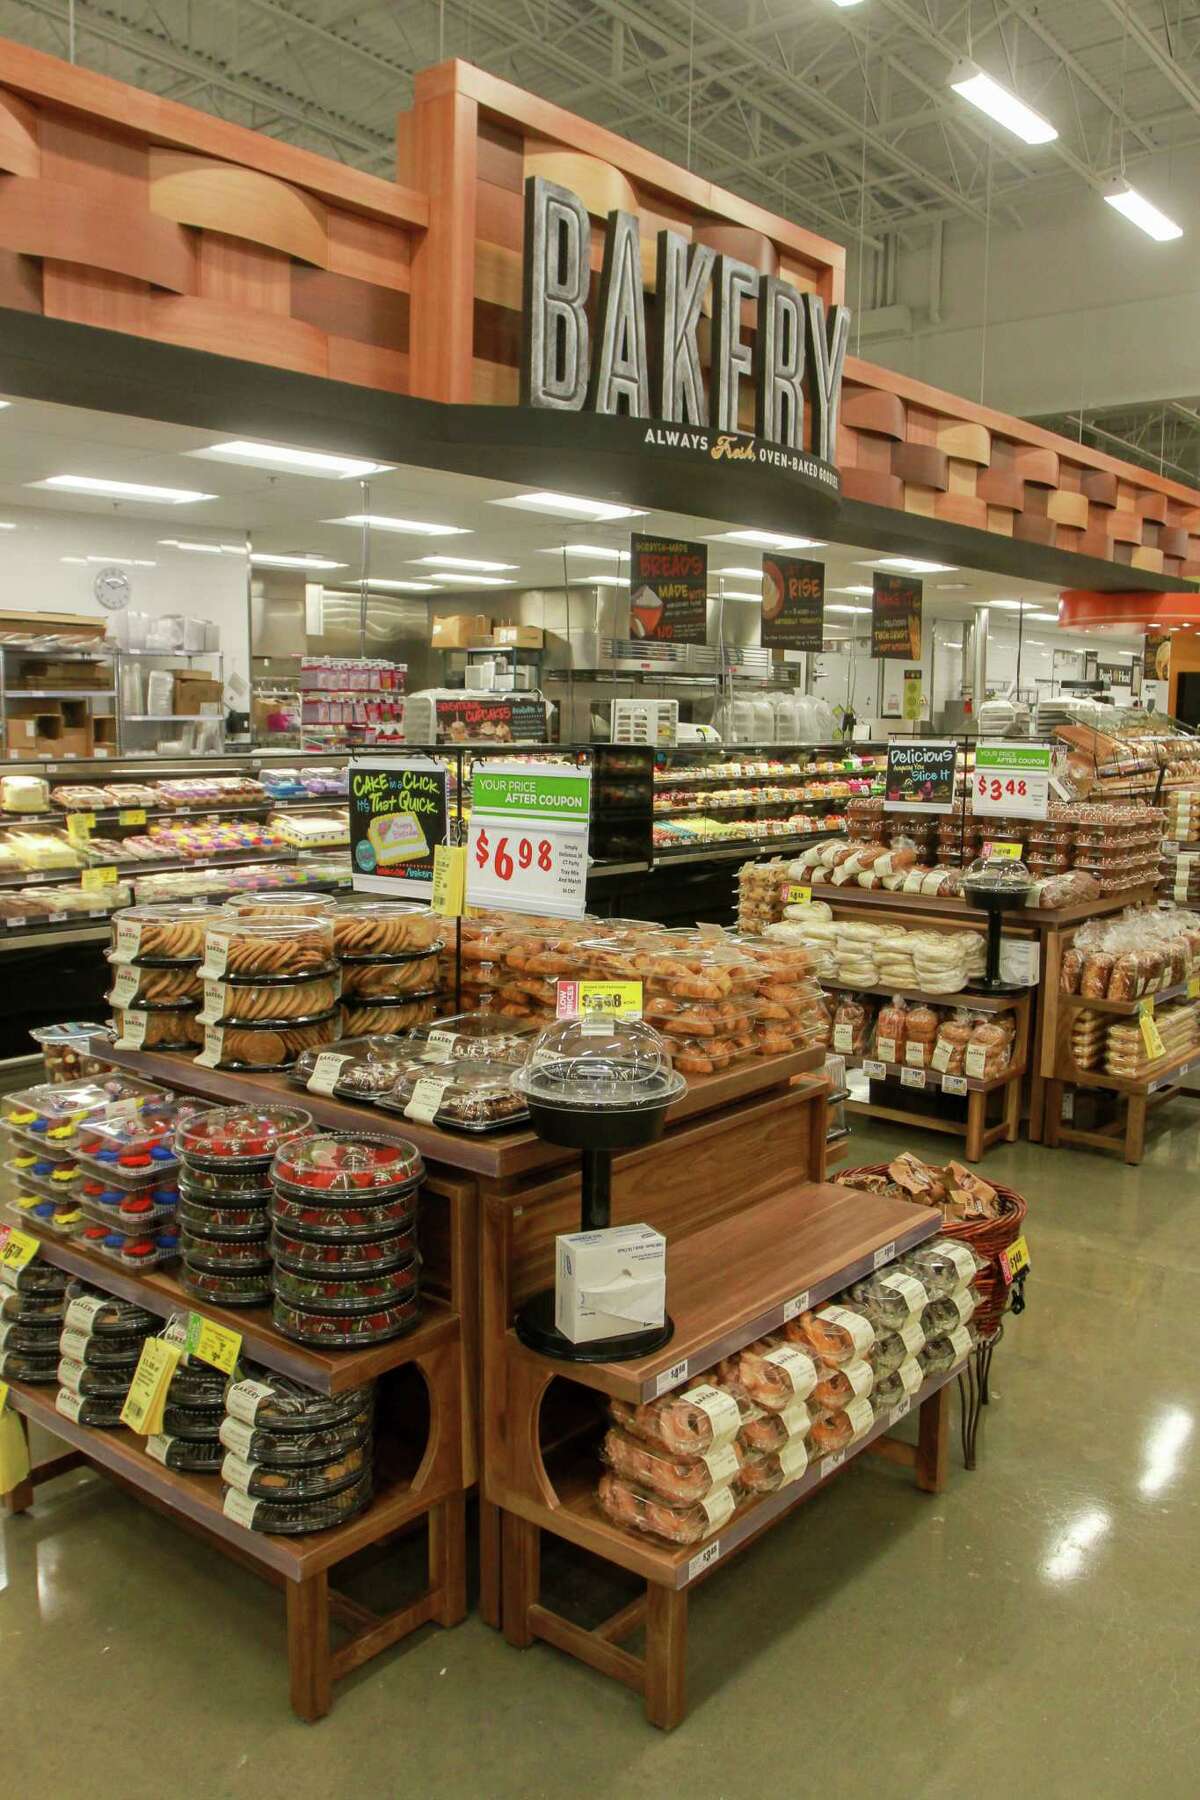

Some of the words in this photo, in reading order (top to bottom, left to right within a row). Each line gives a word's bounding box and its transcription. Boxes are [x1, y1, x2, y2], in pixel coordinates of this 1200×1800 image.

[525, 176, 851, 467] BAKERY
[644, 428, 708, 450] ALWAYS
[760, 448, 818, 478] OVEN-BAKED
[658, 584, 689, 598] MADE
[788, 578, 821, 599] RISE
[890, 747, 954, 764] Delicious
[981, 750, 998, 758] YOUR
[912, 770, 938, 781] Slice
[940, 769, 951, 780] It
[353, 773, 389, 796] CAKE
[480, 779, 506, 790] YOUR
[508, 781, 536, 793] PRICE
[504, 793, 537, 805] AFTER
[539, 795, 582, 807] COUPON
[559, 990, 567, 1010] LOW
[566, 984, 575, 1015] PRICES
[71, 1301, 95, 1313] BAKERY
[233, 1385, 261, 1400] BAKERY
[694, 1391, 719, 1405] BAKERY
